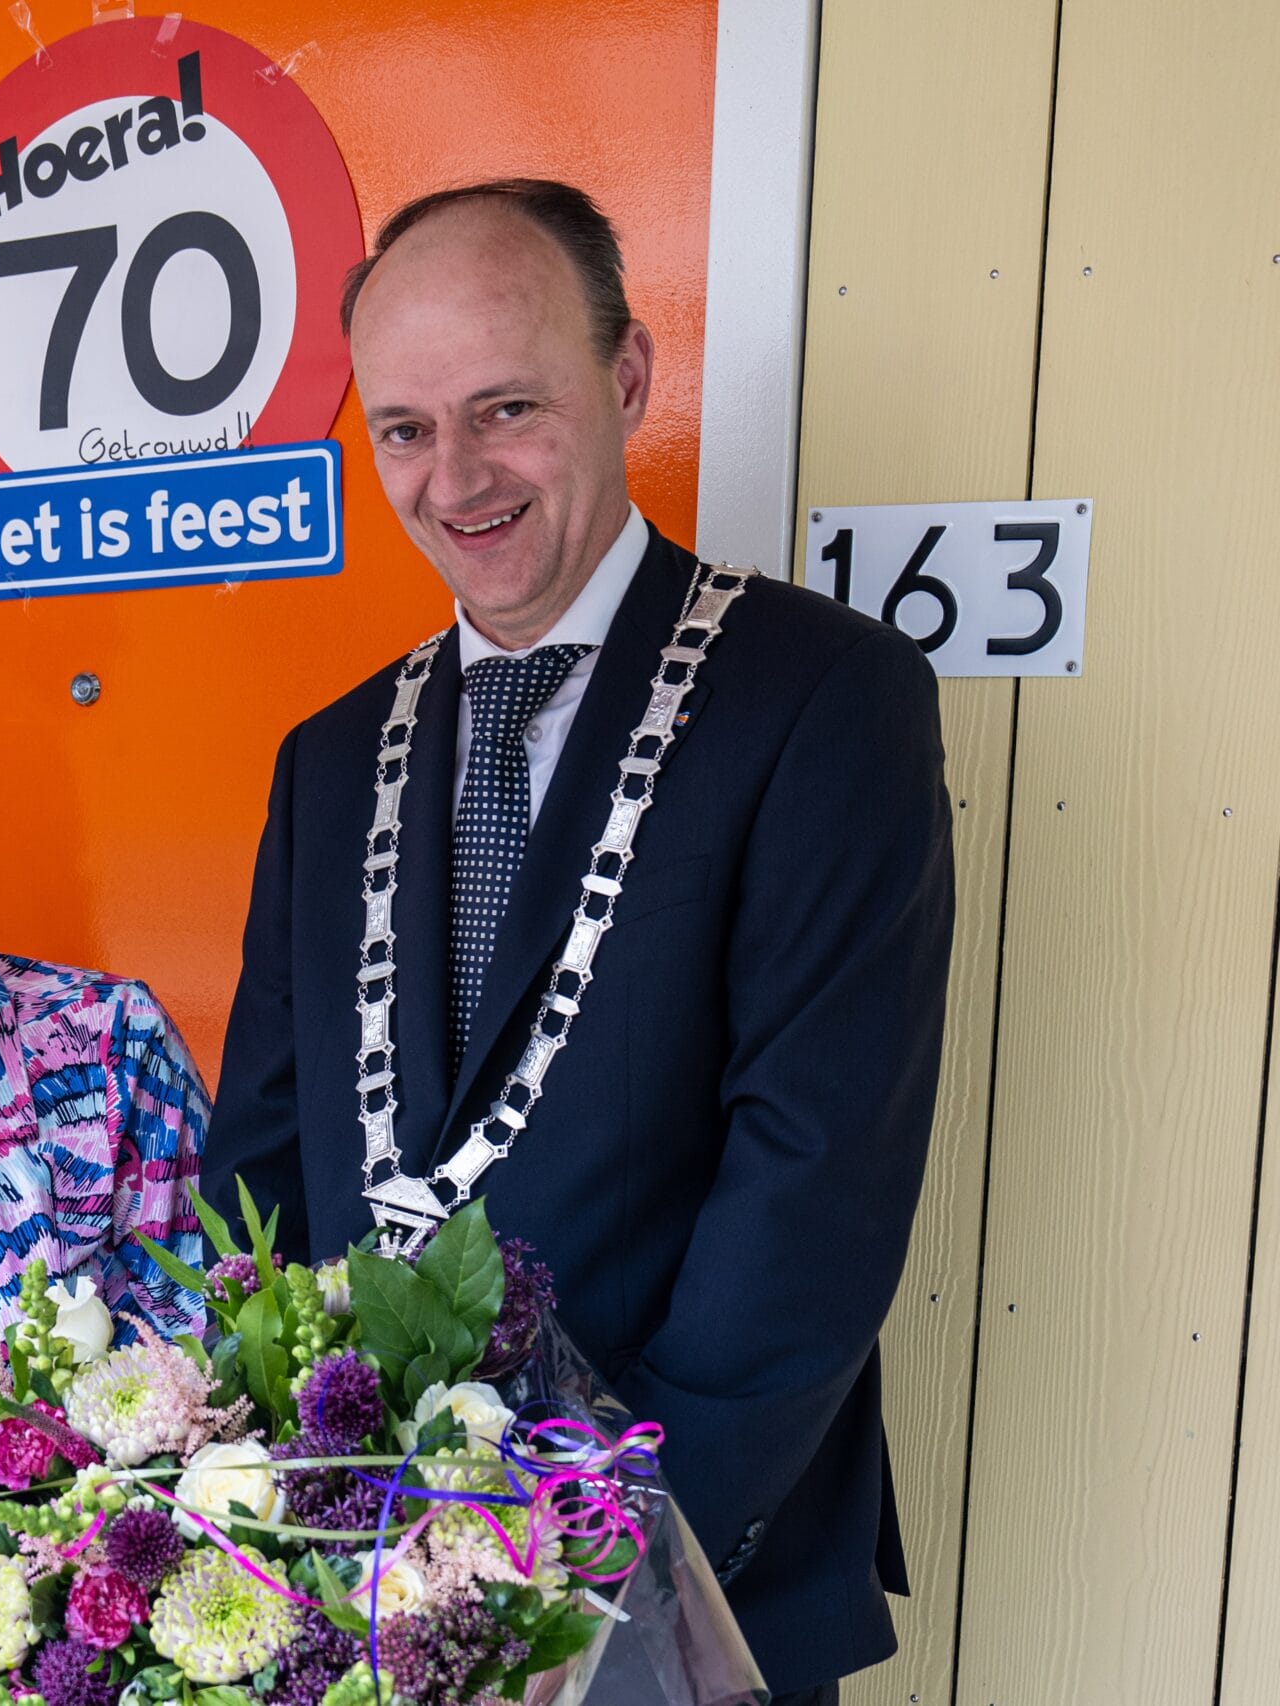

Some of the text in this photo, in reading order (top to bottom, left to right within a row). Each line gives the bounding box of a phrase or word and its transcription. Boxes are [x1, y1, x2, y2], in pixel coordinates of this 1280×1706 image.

[79, 497, 130, 559] is
[145, 476, 312, 553] feest
[821, 522, 1062, 655] 163
